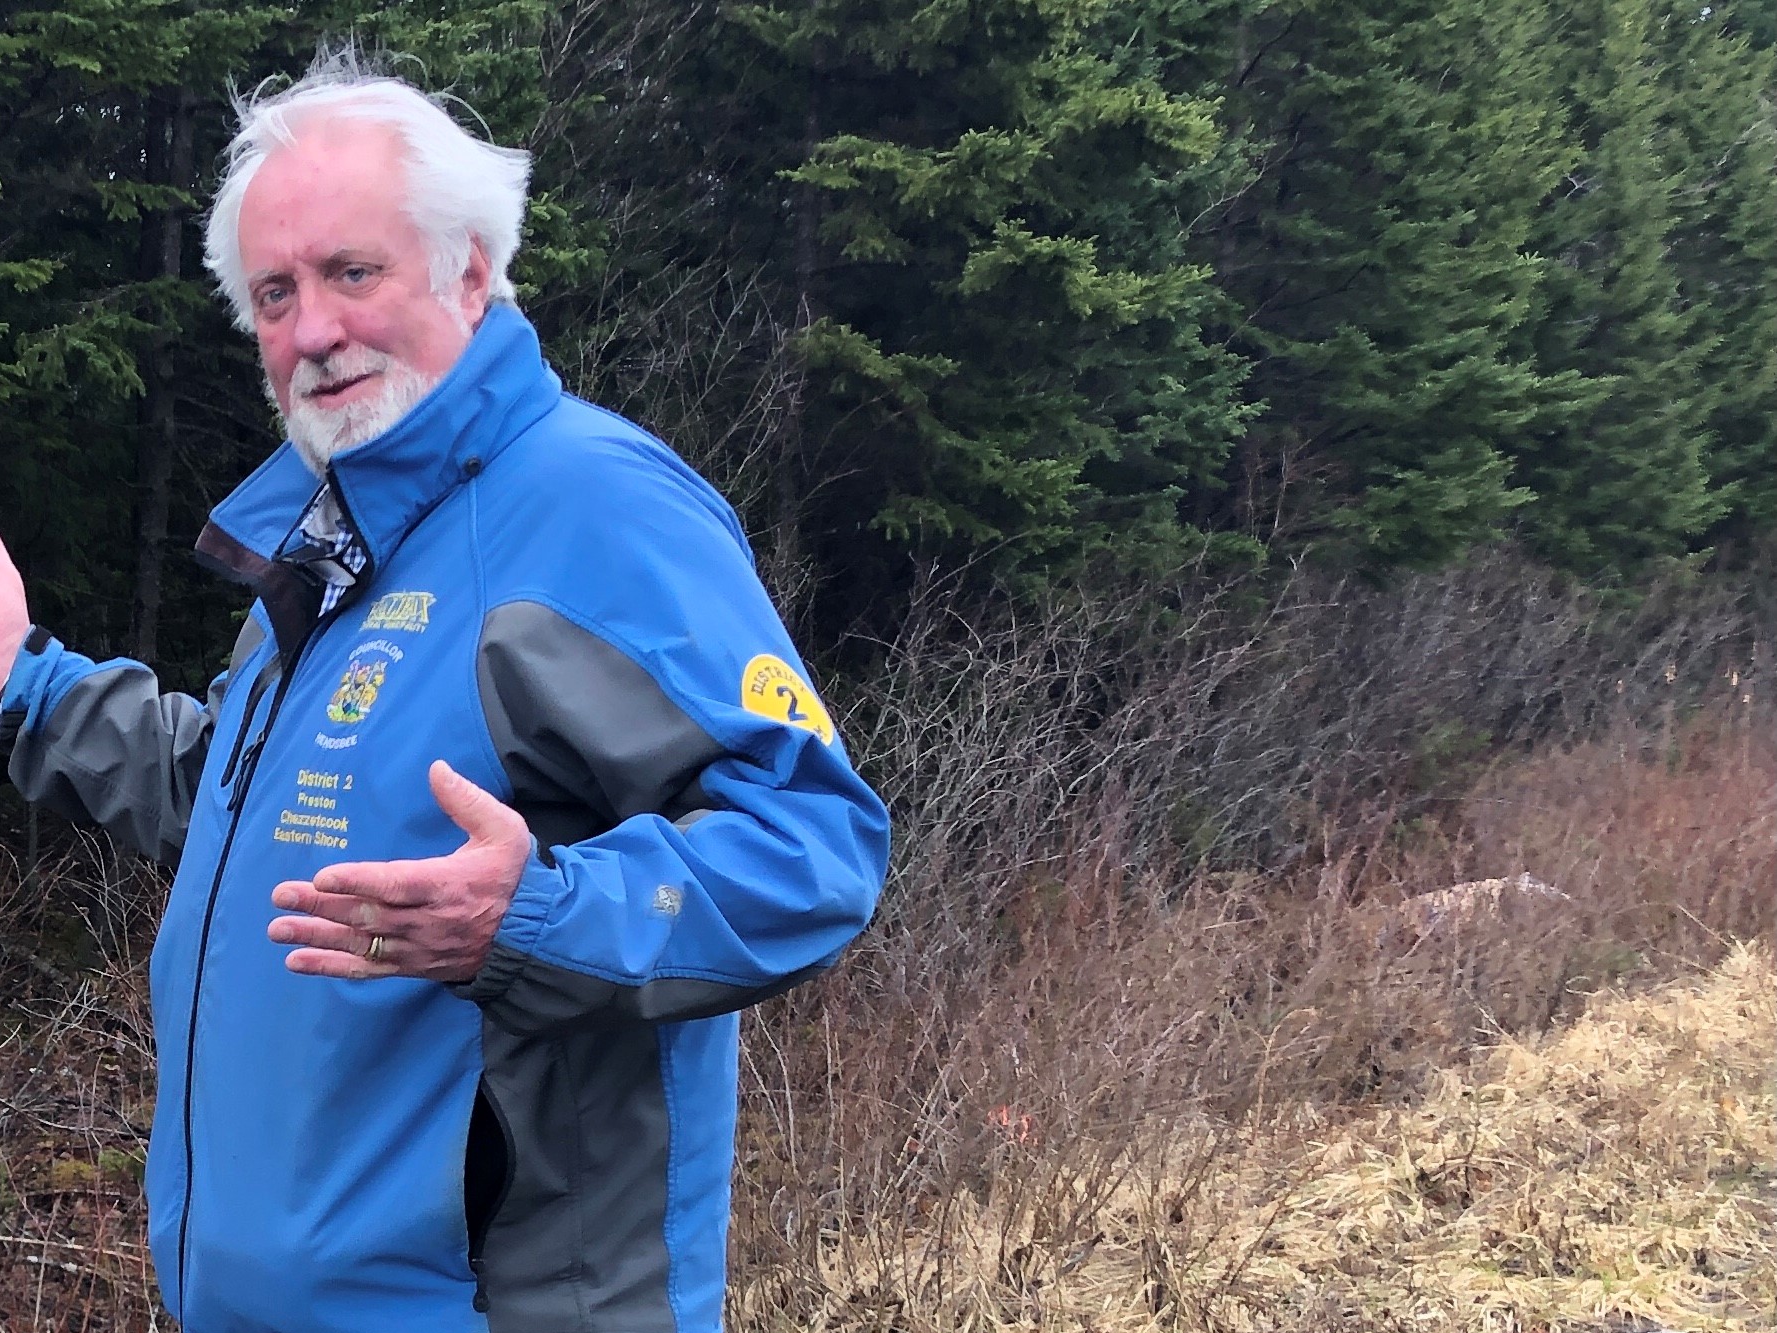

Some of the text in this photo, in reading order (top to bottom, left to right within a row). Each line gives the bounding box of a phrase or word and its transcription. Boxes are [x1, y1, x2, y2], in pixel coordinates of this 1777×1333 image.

[776, 686, 808, 721] 2
[297, 769, 354, 790] District 2
[297, 792, 336, 810] Preston
[273, 826, 349, 849] Eastern Shore
